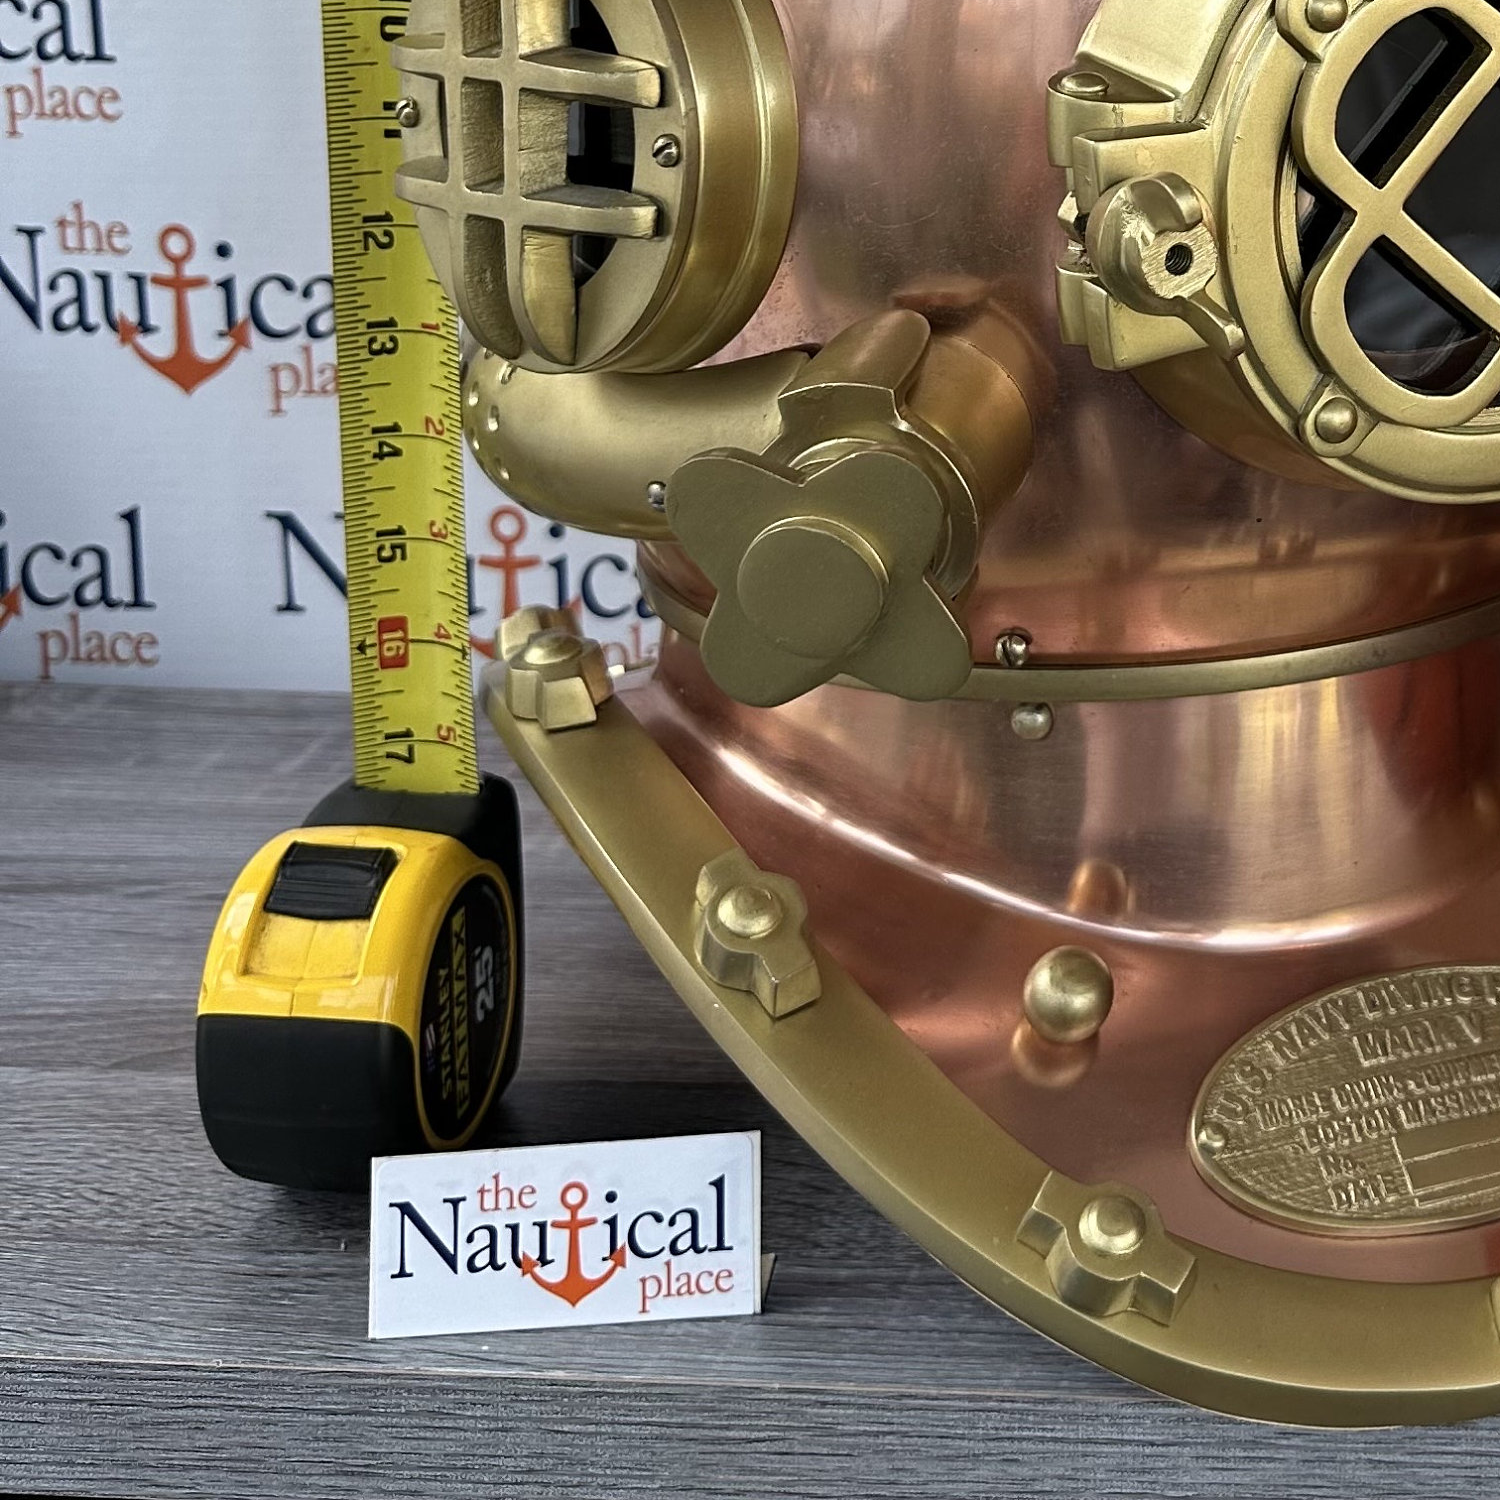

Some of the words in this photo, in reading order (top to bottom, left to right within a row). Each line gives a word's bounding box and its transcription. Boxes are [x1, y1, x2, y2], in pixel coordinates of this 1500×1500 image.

[3, 65, 125, 140] place
[54, 199, 132, 256] the
[362, 210, 396, 250] 12
[364, 316, 399, 356] 13
[371, 421, 404, 461] 14
[375, 524, 408, 564] 15
[37, 609, 161, 682] place
[381, 627, 407, 658] 16
[383, 727, 415, 765] 17
[438, 965, 452, 1100] STANLEY
[1264, 994, 1351, 1067] NAVY
[1355, 974, 1475, 1021] DIVING
[1352, 1018, 1458, 1068] MARK
[476, 1172, 538, 1211] the
[389, 1175, 733, 1308] Nautical
[638, 1258, 736, 1315] place
